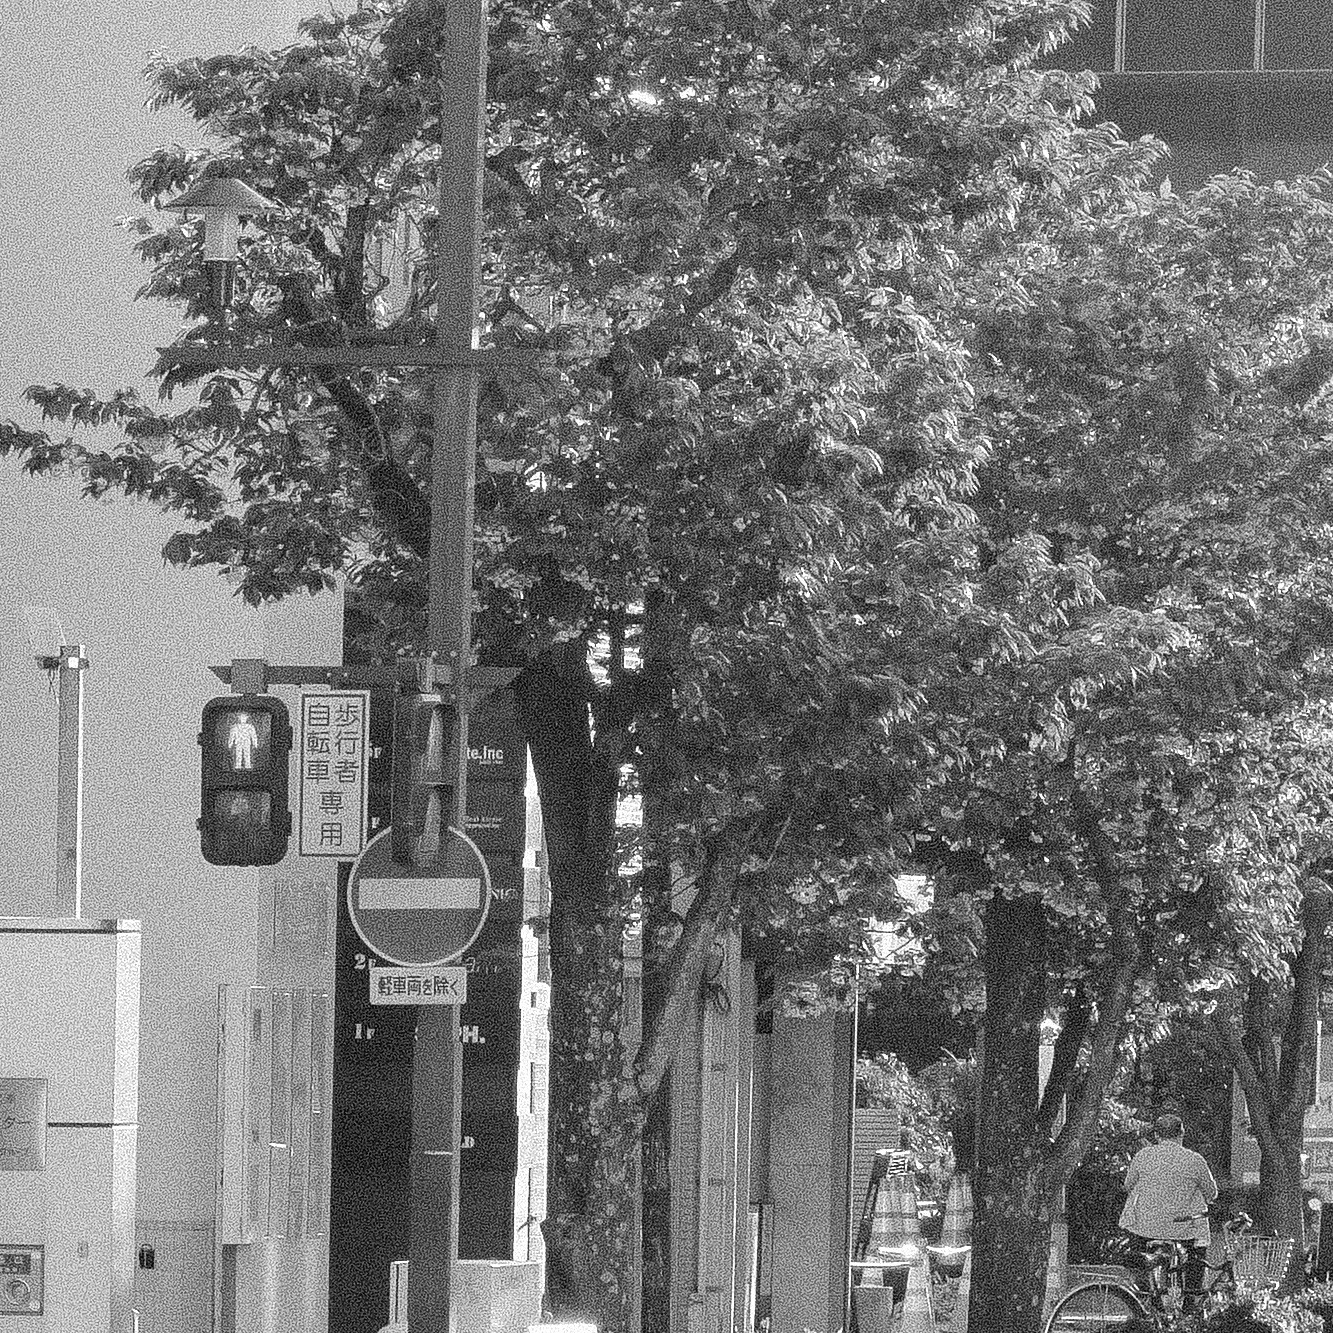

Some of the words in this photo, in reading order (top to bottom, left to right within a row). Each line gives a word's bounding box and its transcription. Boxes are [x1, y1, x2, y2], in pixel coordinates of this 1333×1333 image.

[307, 702, 331, 785] 自転車
[334, 702, 360, 785] 歩行者
[319, 790, 344, 847] 専用
[378, 975, 458, 996] 軽車両を除く
